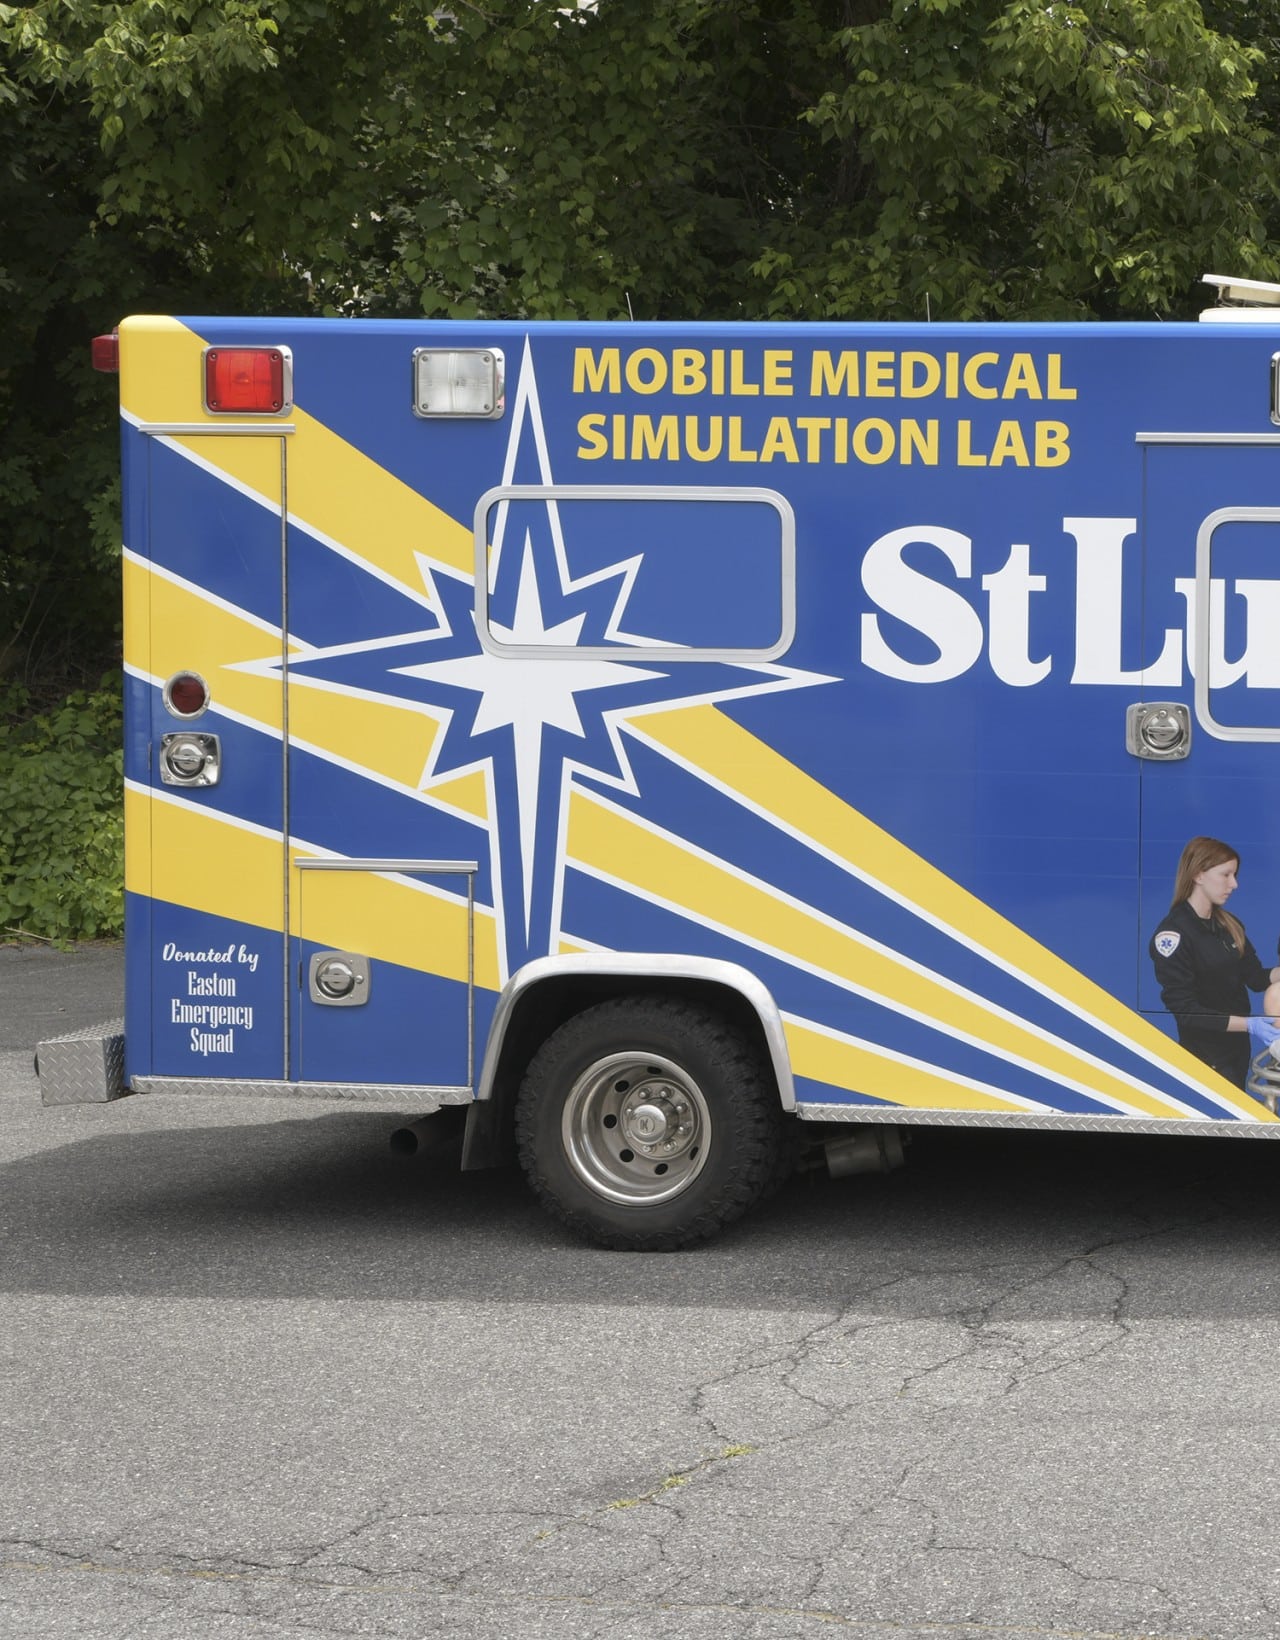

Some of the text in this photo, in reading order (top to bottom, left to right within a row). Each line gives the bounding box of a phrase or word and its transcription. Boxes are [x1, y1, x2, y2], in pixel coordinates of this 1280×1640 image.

[572, 347, 1077, 400] MOBILE MEDICAL
[576, 413, 1070, 467] SIMULATION LAB
[163, 942, 259, 972] Donated by
[188, 971, 236, 997] Easton
[171, 998, 253, 1030] Emergency
[190, 1027, 234, 1056] Squad
